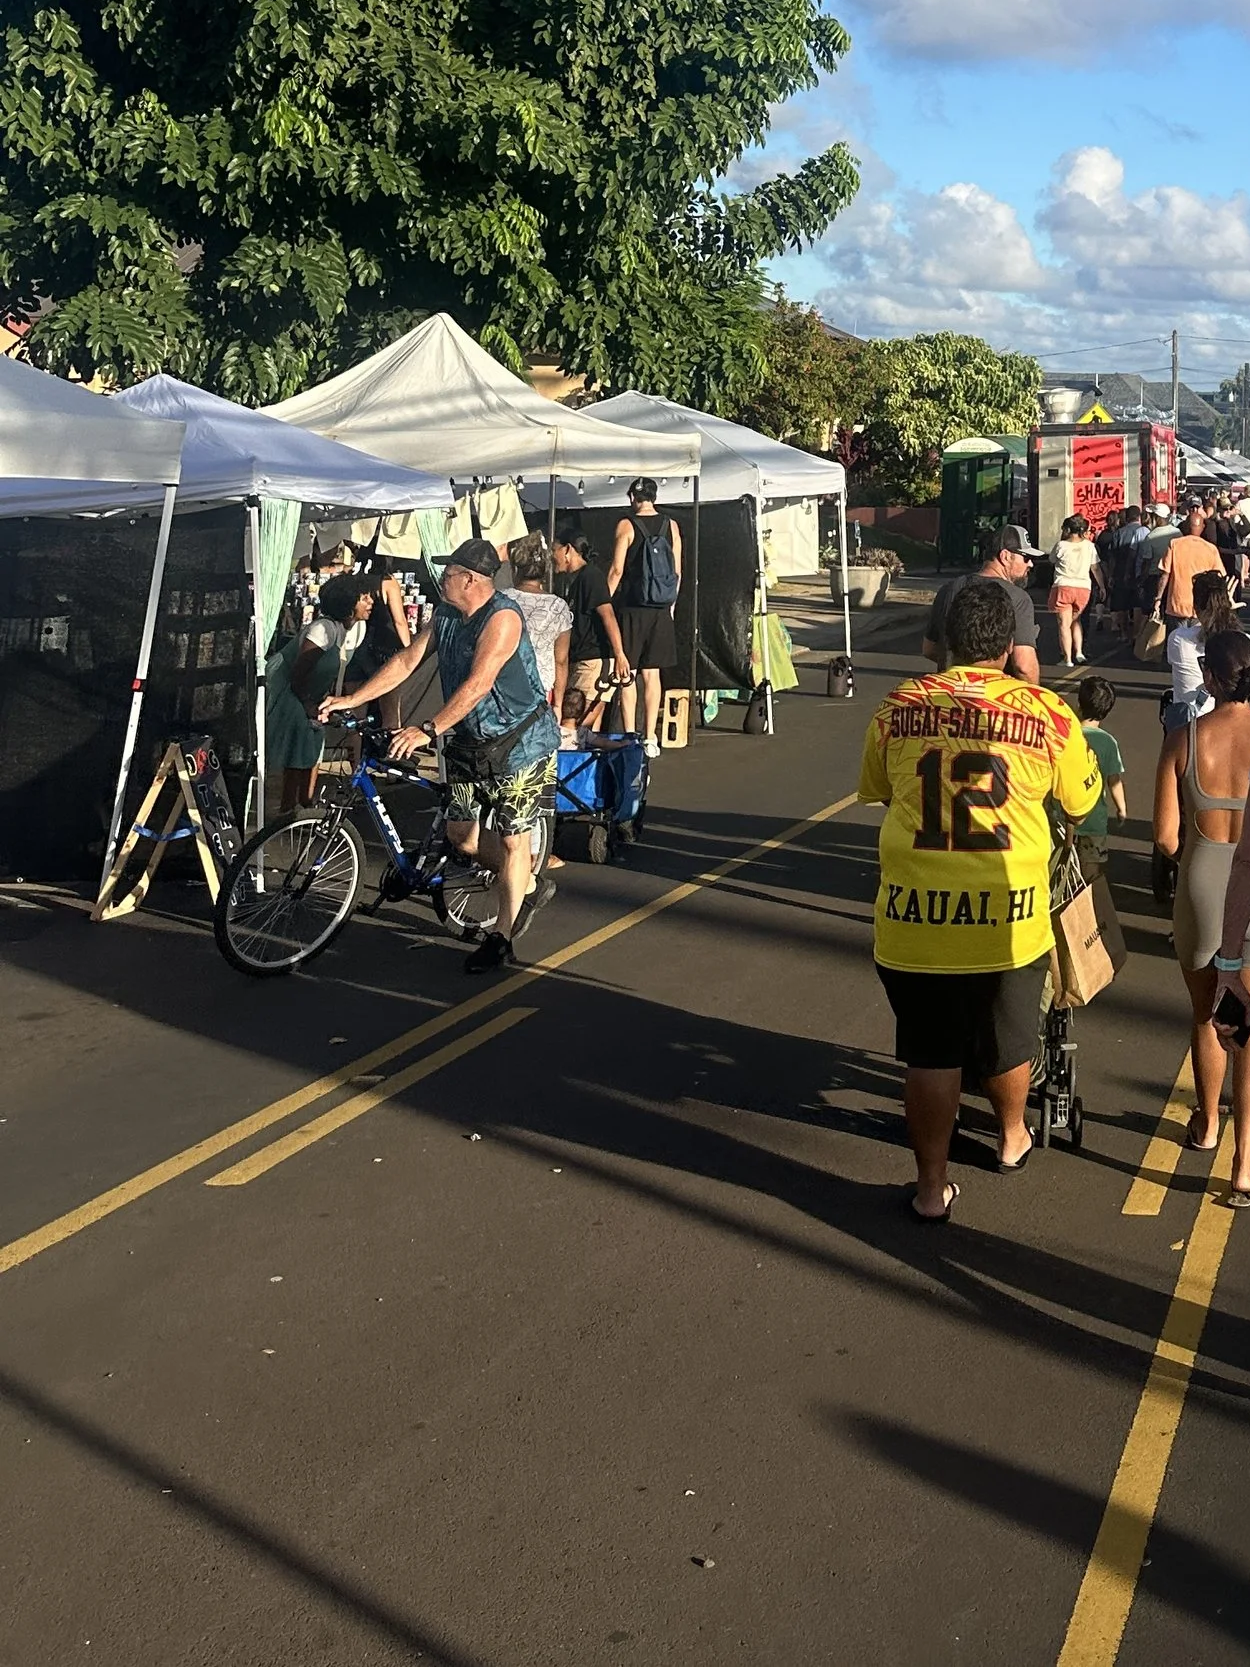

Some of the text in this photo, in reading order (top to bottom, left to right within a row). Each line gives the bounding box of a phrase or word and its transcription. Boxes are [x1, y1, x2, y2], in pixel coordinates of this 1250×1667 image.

[890, 705, 1046, 749] SUGAI-SALVADOR
[372, 795, 405, 854] HUFFY
[912, 749, 1012, 853] 12
[885, 884, 1036, 927] KAUAI, HI
